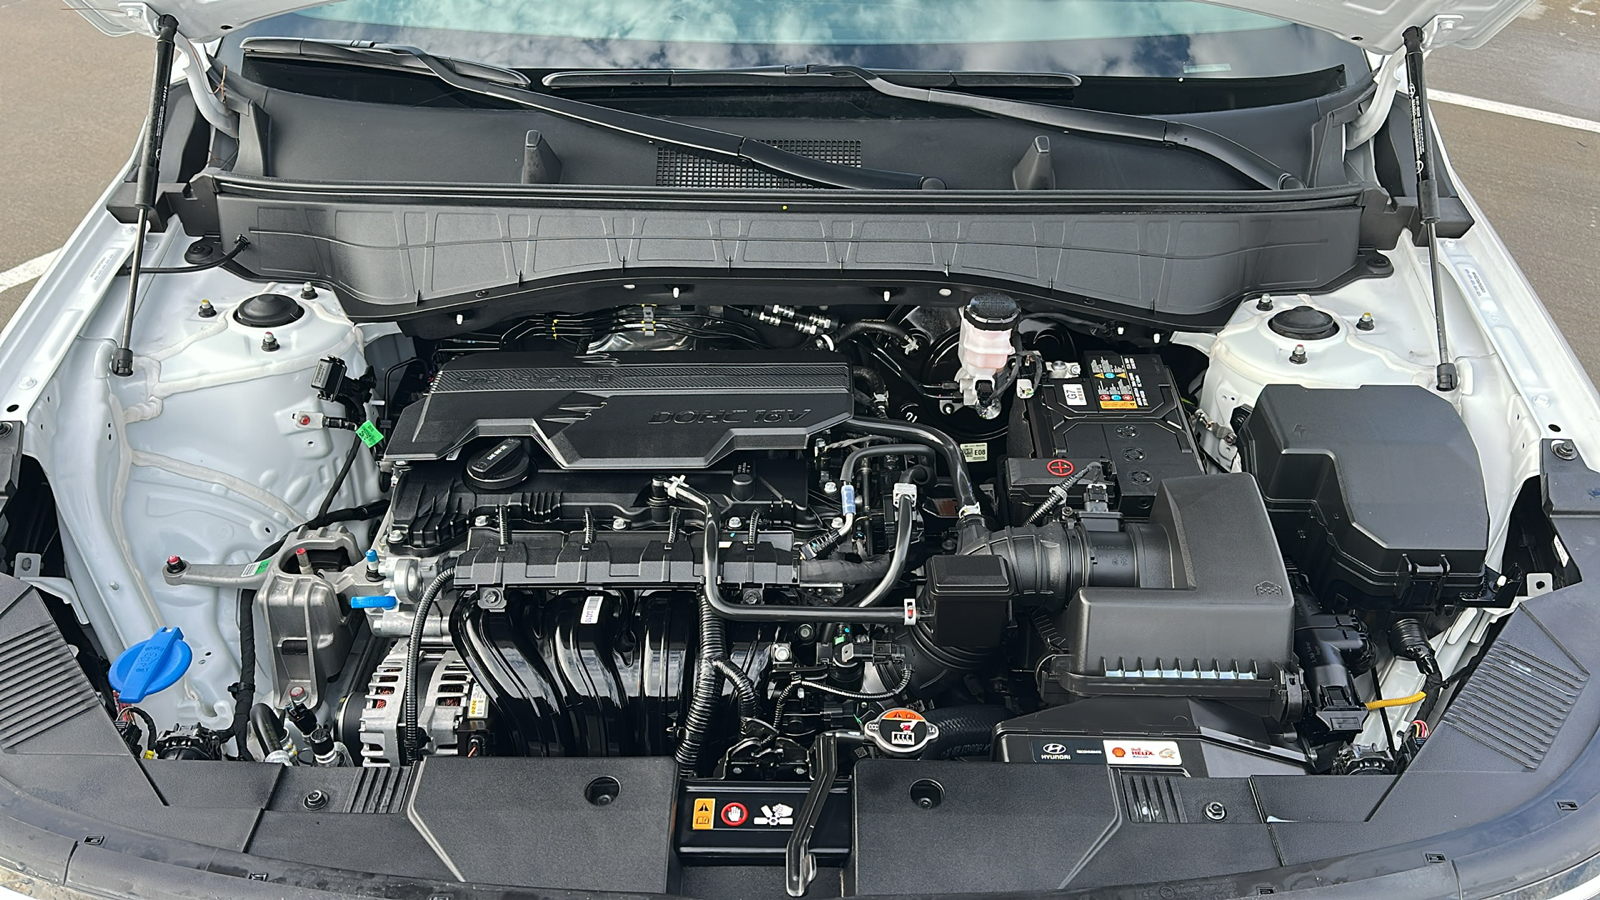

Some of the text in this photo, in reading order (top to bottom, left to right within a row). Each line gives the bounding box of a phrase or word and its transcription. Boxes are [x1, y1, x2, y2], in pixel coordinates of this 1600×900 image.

[1066, 389, 1078, 400] G7
[648, 409, 812, 425] DOHC 16V
